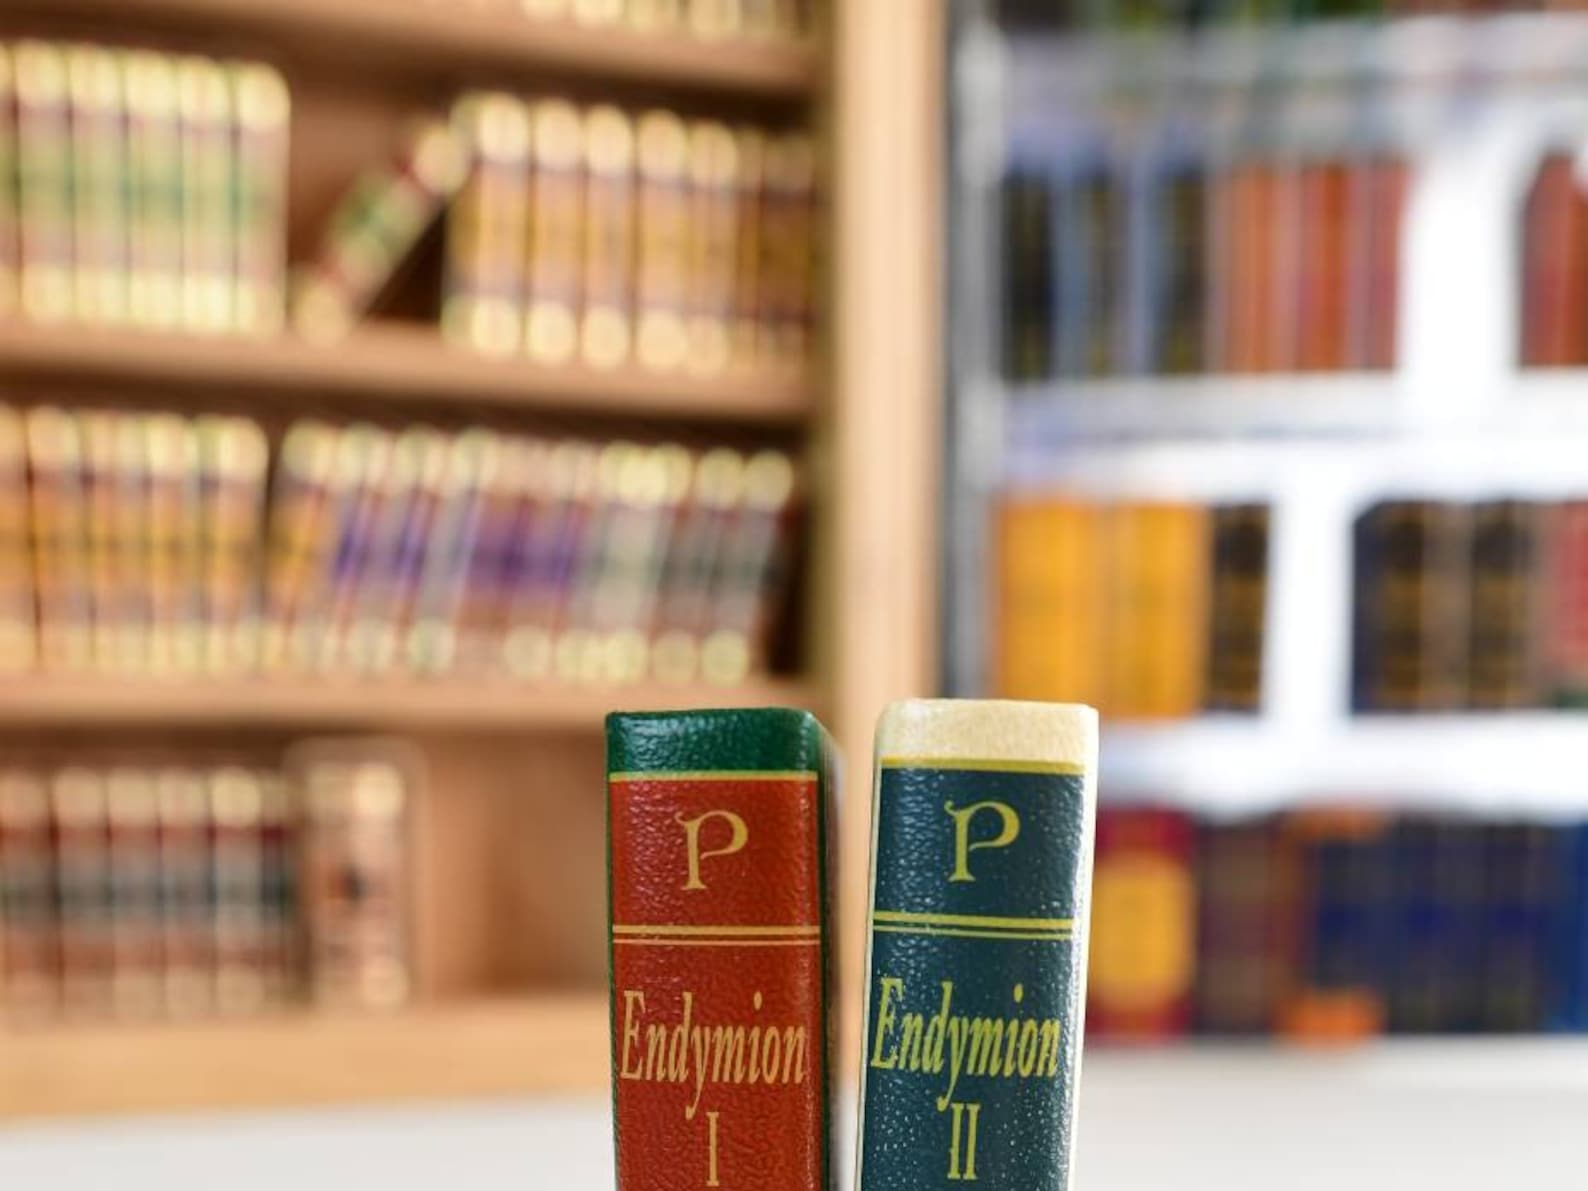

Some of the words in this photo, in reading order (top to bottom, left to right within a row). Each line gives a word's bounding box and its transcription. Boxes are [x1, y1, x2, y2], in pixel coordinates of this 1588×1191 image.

[674, 810, 749, 891] P
[943, 800, 1021, 882] P
[620, 990, 806, 1120] Endymion
[871, 976, 1061, 1112] Endymion
[706, 1111, 720, 1187] I
[947, 1102, 981, 1181] II
